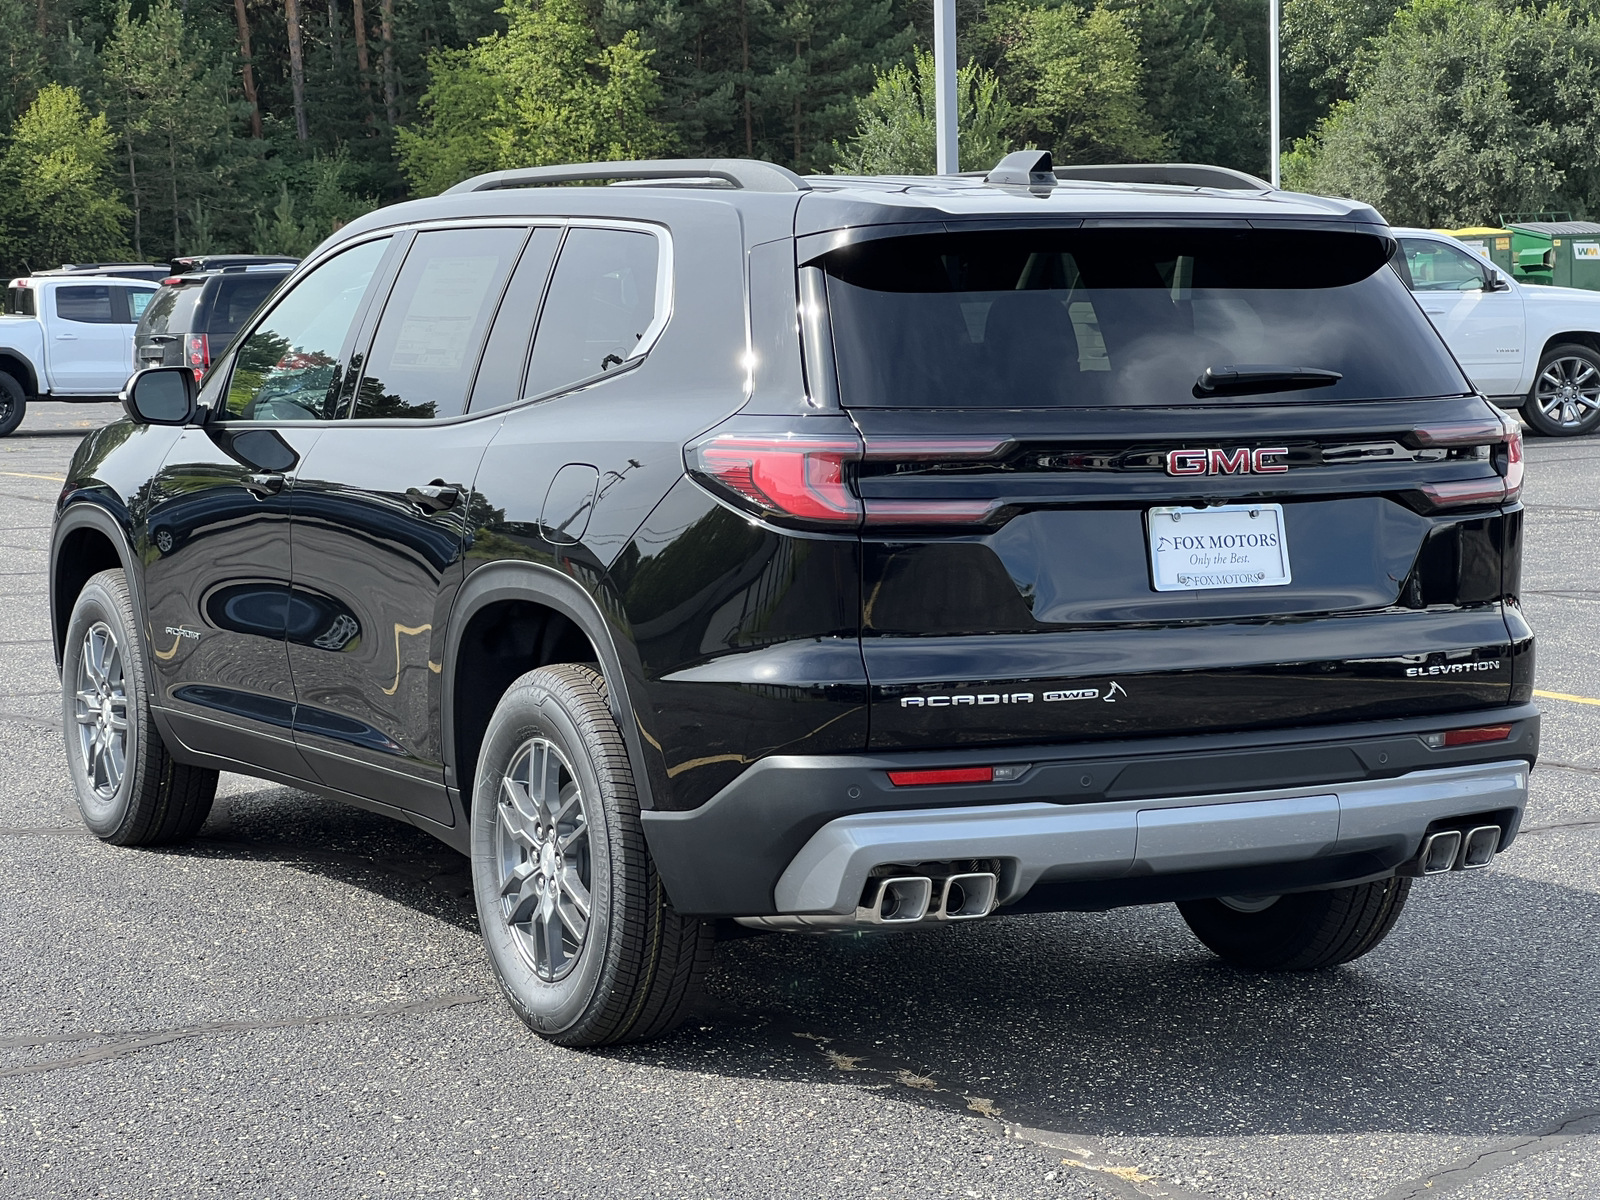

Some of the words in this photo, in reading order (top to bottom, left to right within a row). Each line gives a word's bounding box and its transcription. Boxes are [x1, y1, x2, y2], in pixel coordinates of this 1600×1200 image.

[1577, 247, 1598, 256] WM
[1166, 447, 1289, 476] GMC
[1173, 535, 1206, 550] FOX
[1209, 533, 1277, 549] MOTORS
[1189, 553, 1211, 568] Only
[1213, 553, 1227, 565] the
[1230, 552, 1250, 564] Best.
[1194, 575, 1215, 586] FOX
[1216, 572, 1260, 585] MOTORS
[1405, 660, 1501, 677] ELEVATION
[900, 692, 1034, 708] ACADIA
[1045, 689, 1098, 701] AWD
